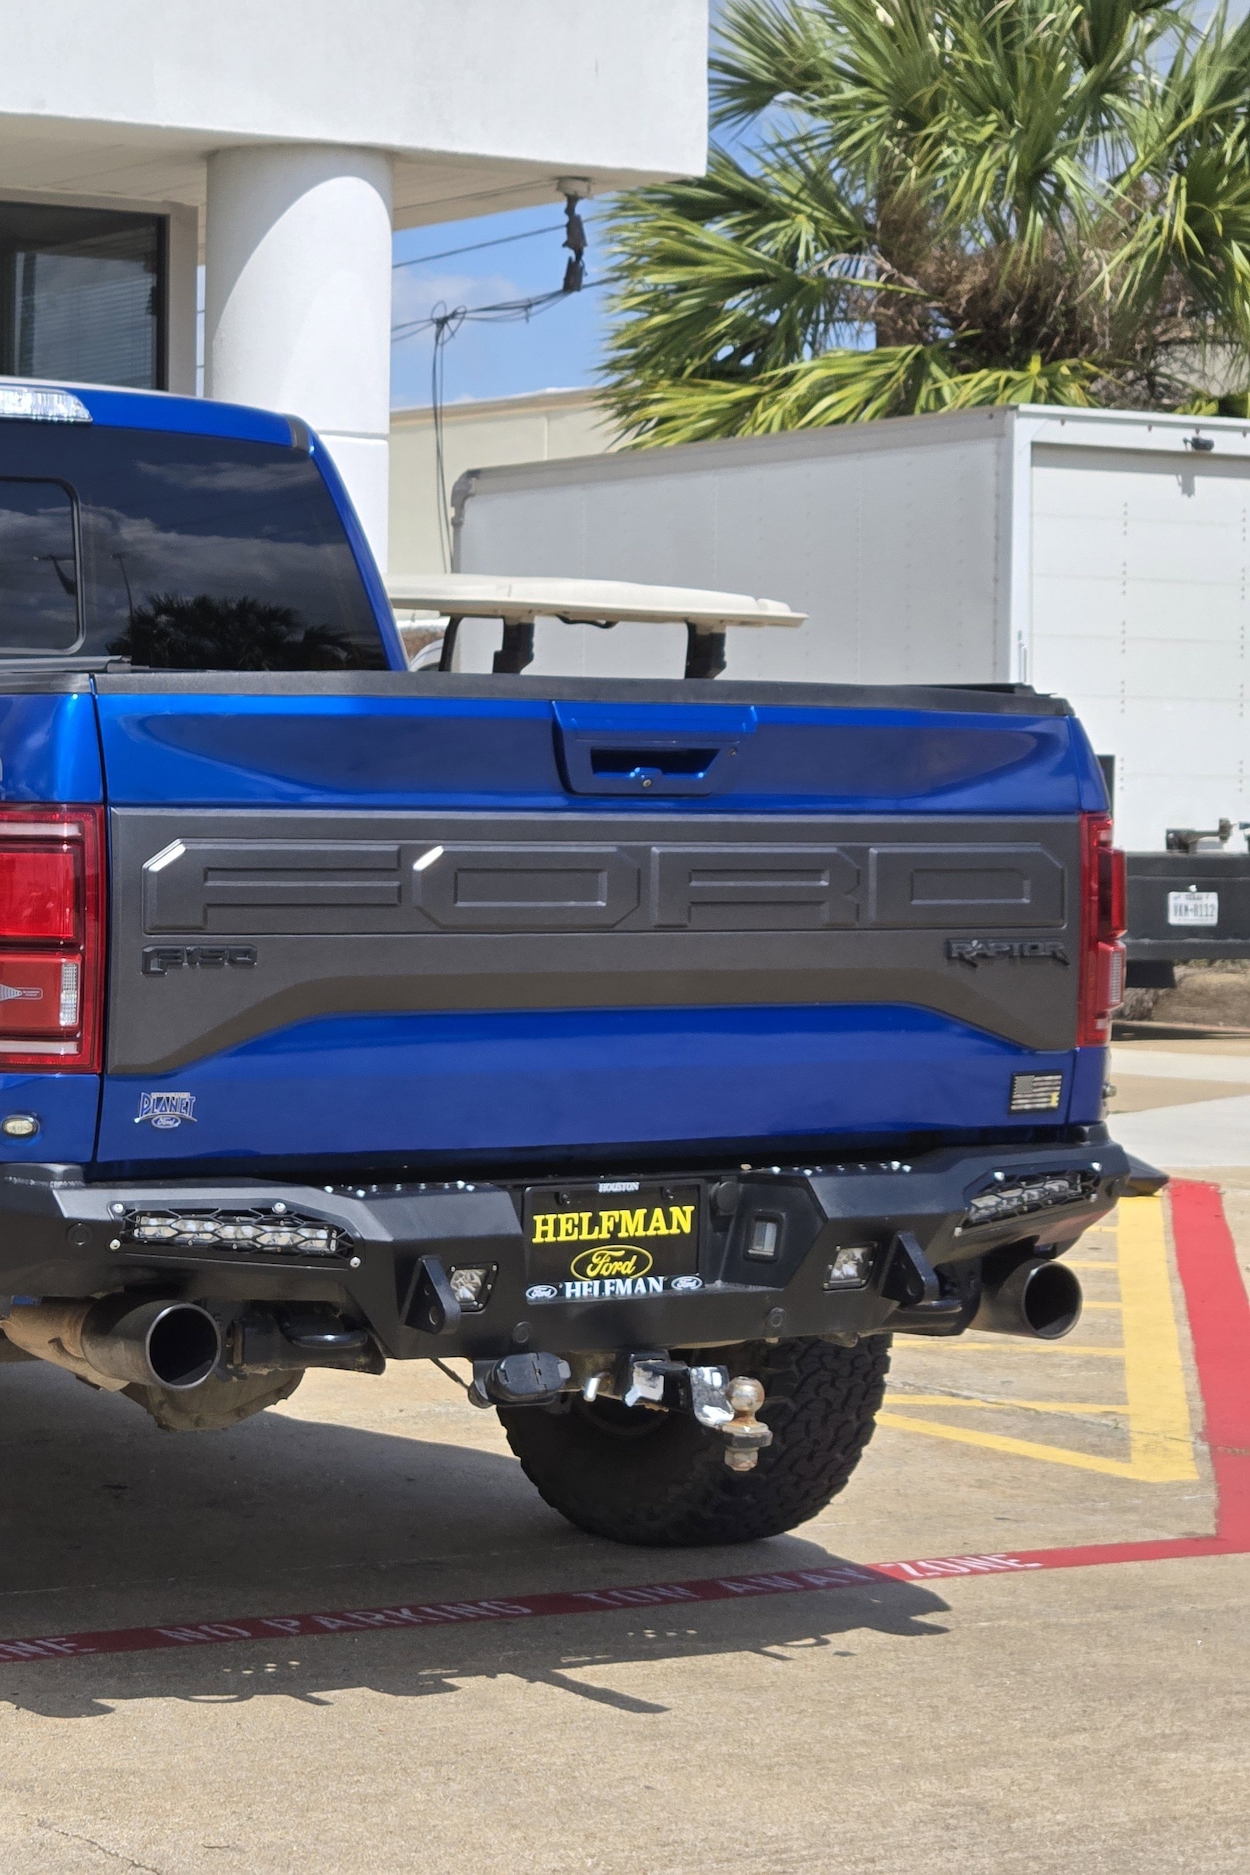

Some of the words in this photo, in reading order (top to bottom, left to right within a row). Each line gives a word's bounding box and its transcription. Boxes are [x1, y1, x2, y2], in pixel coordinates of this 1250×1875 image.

[141, 838, 1068, 936] FORD
[946, 937, 1070, 968] RAPTOR
[139, 1092, 196, 1118] PLANET
[598, 1182, 640, 1193] HOUSTON
[532, 1205, 695, 1244] HELFMAN
[564, 1276, 666, 1298] HELFMAN
[154, 1623, 252, 1642] NO
[261, 1600, 532, 1635] PARKING
[574, 1585, 702, 1607] TOW
[715, 1567, 876, 1595] AWAY
[879, 1553, 1044, 1580] ZONE
